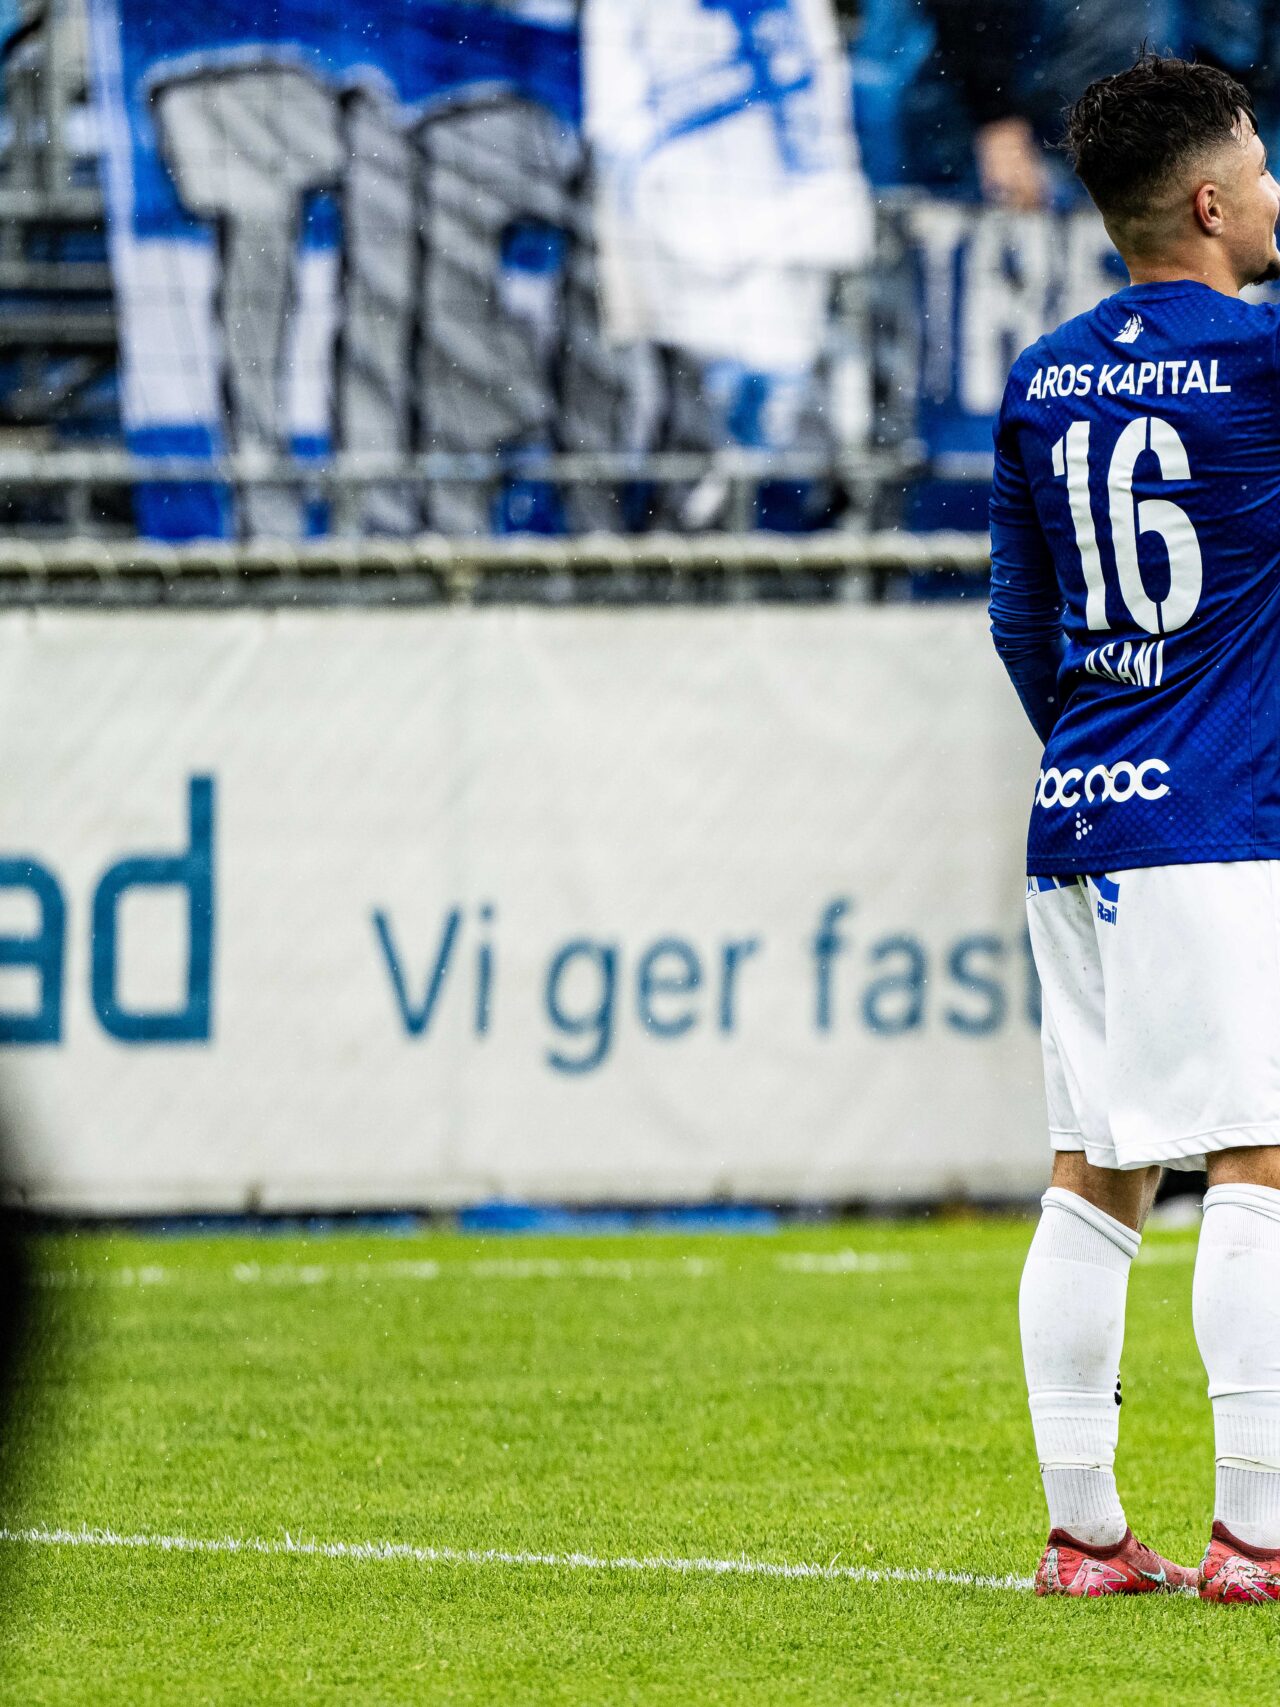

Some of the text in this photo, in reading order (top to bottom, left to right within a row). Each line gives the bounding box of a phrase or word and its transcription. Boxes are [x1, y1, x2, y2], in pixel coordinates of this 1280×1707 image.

[1026, 359, 1231, 401] AROS KAPITAL
[1051, 416, 1203, 635] 16
[1085, 639, 1165, 687] ASANI
[1097, 900, 1118, 926] Rail
[370, 903, 494, 1038] Vi
[545, 935, 760, 1077] ger
